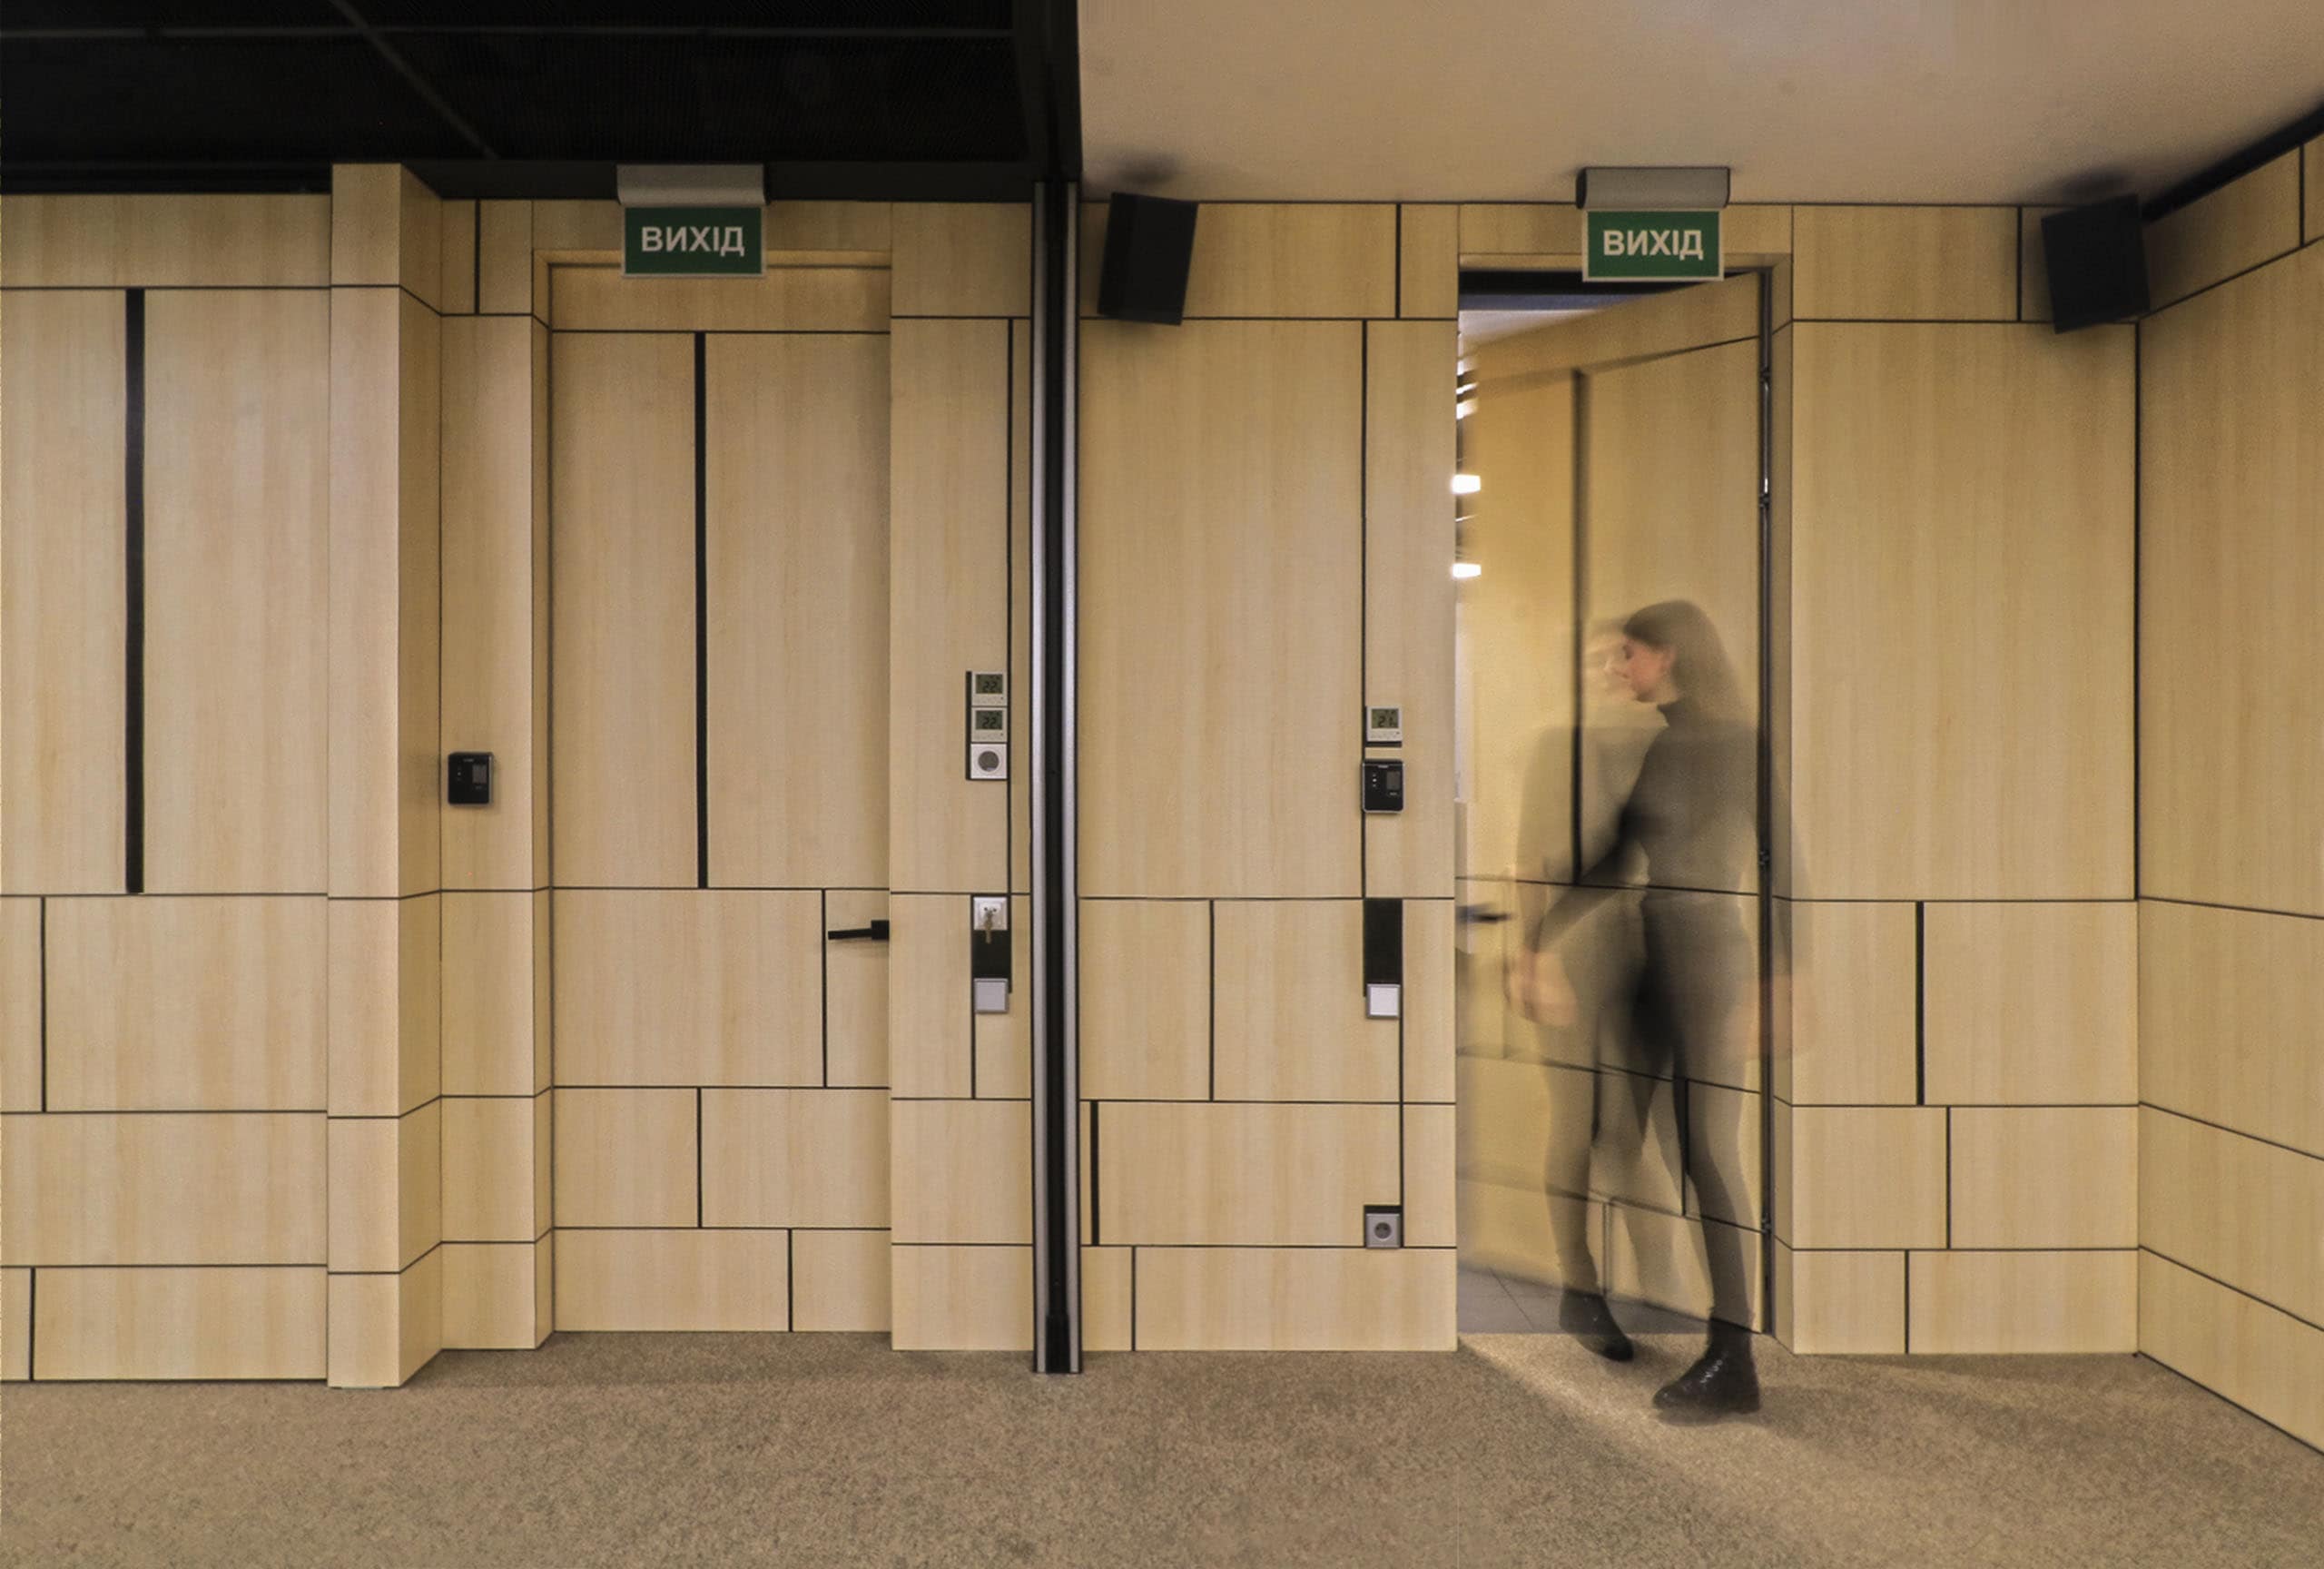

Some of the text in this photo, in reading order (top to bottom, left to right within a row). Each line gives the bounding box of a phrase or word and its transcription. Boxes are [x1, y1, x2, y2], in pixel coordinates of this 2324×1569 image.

[641, 226, 745, 257] ВИХІД
[1603, 230, 1704, 261] ВИХІД
[982, 717, 997, 729] 22
